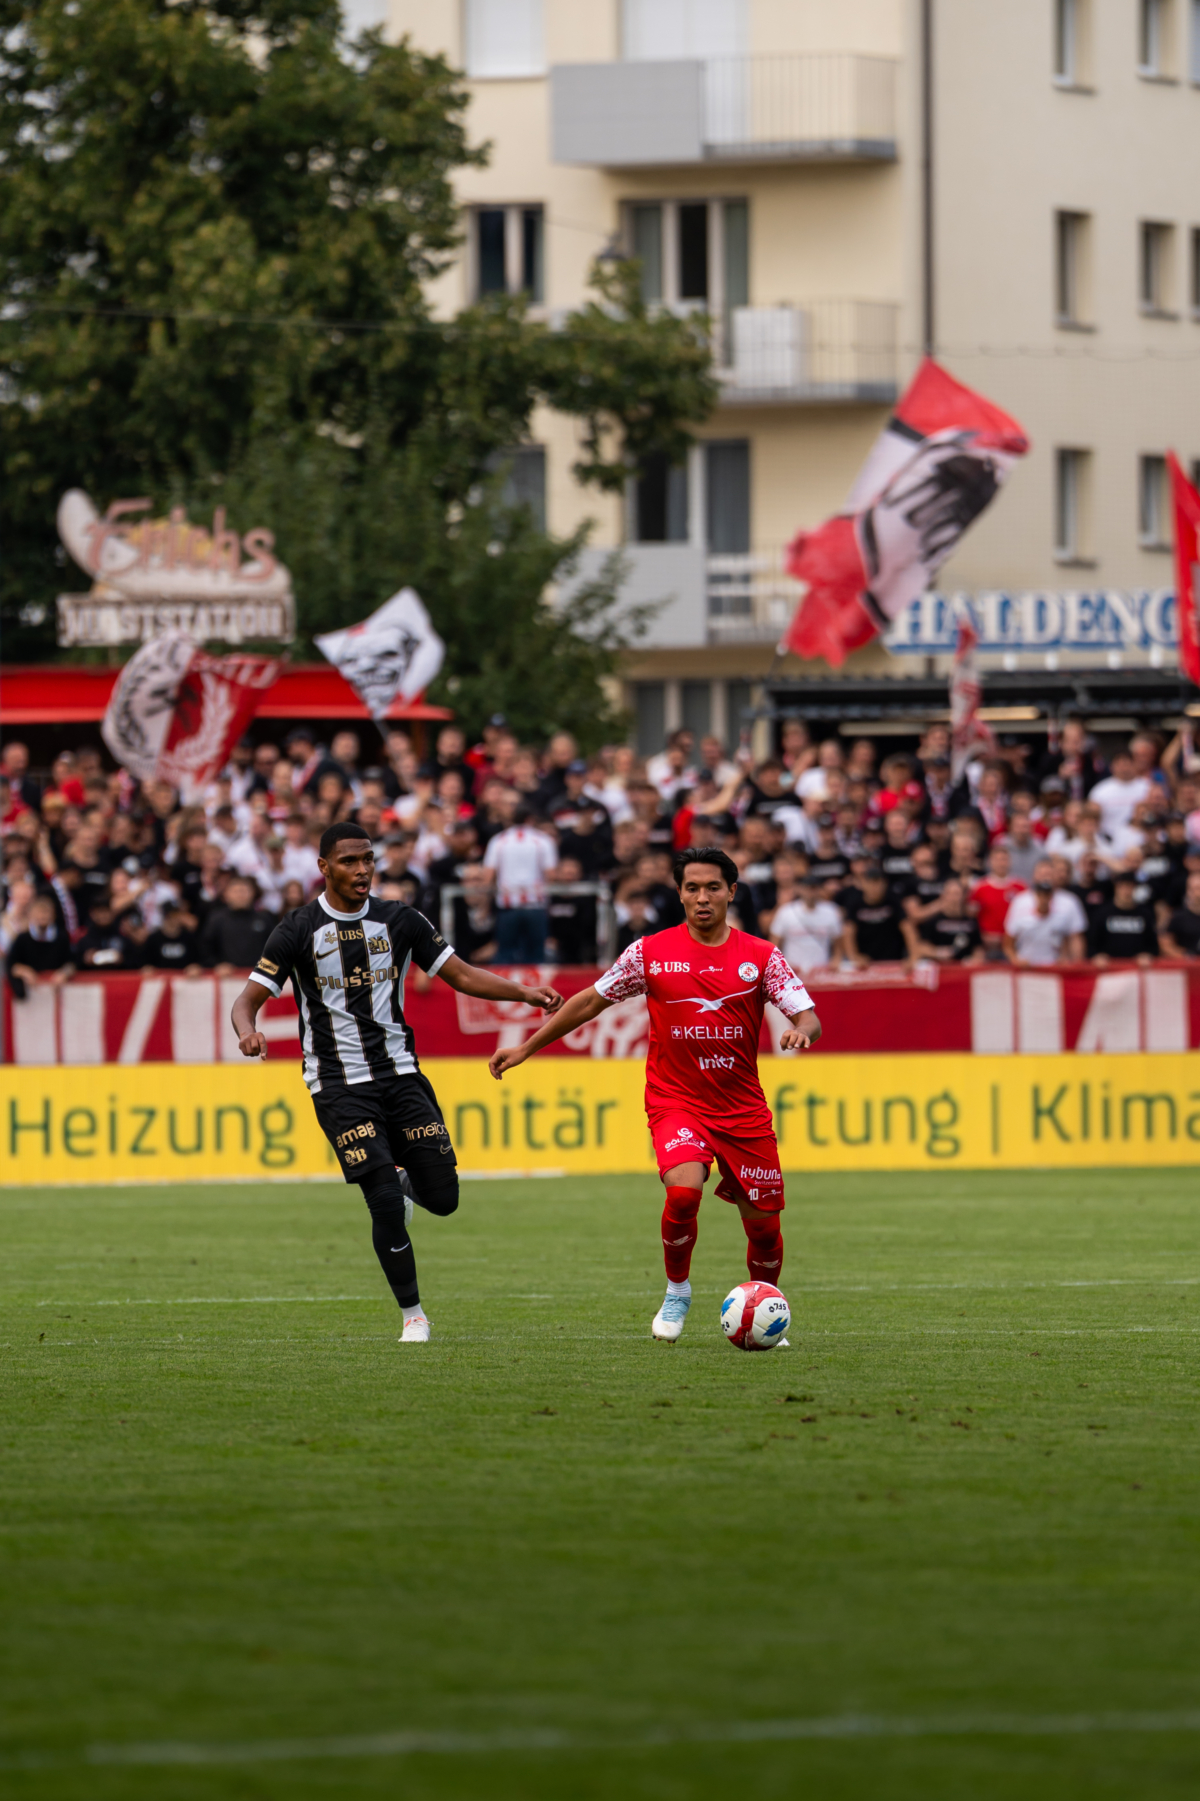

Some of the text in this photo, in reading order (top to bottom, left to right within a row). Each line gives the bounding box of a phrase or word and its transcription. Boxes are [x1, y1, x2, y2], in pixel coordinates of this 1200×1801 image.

[64, 601, 287, 642] WUSTSTATION
[893, 587, 1177, 646] HALDENG
[339, 929, 364, 941] UBS
[664, 962, 690, 973] UBS
[314, 966, 399, 990] Plus500
[684, 1026, 743, 1040] KELLER
[9, 1094, 297, 1168] Heizung
[455, 1087, 619, 1151] nitär
[775, 1083, 961, 1159] ftung
[336, 1121, 377, 1149] amag
[402, 1122, 448, 1141] TimeToo
[740, 1165, 777, 1180] kybun
[748, 1188, 759, 1201] 10
